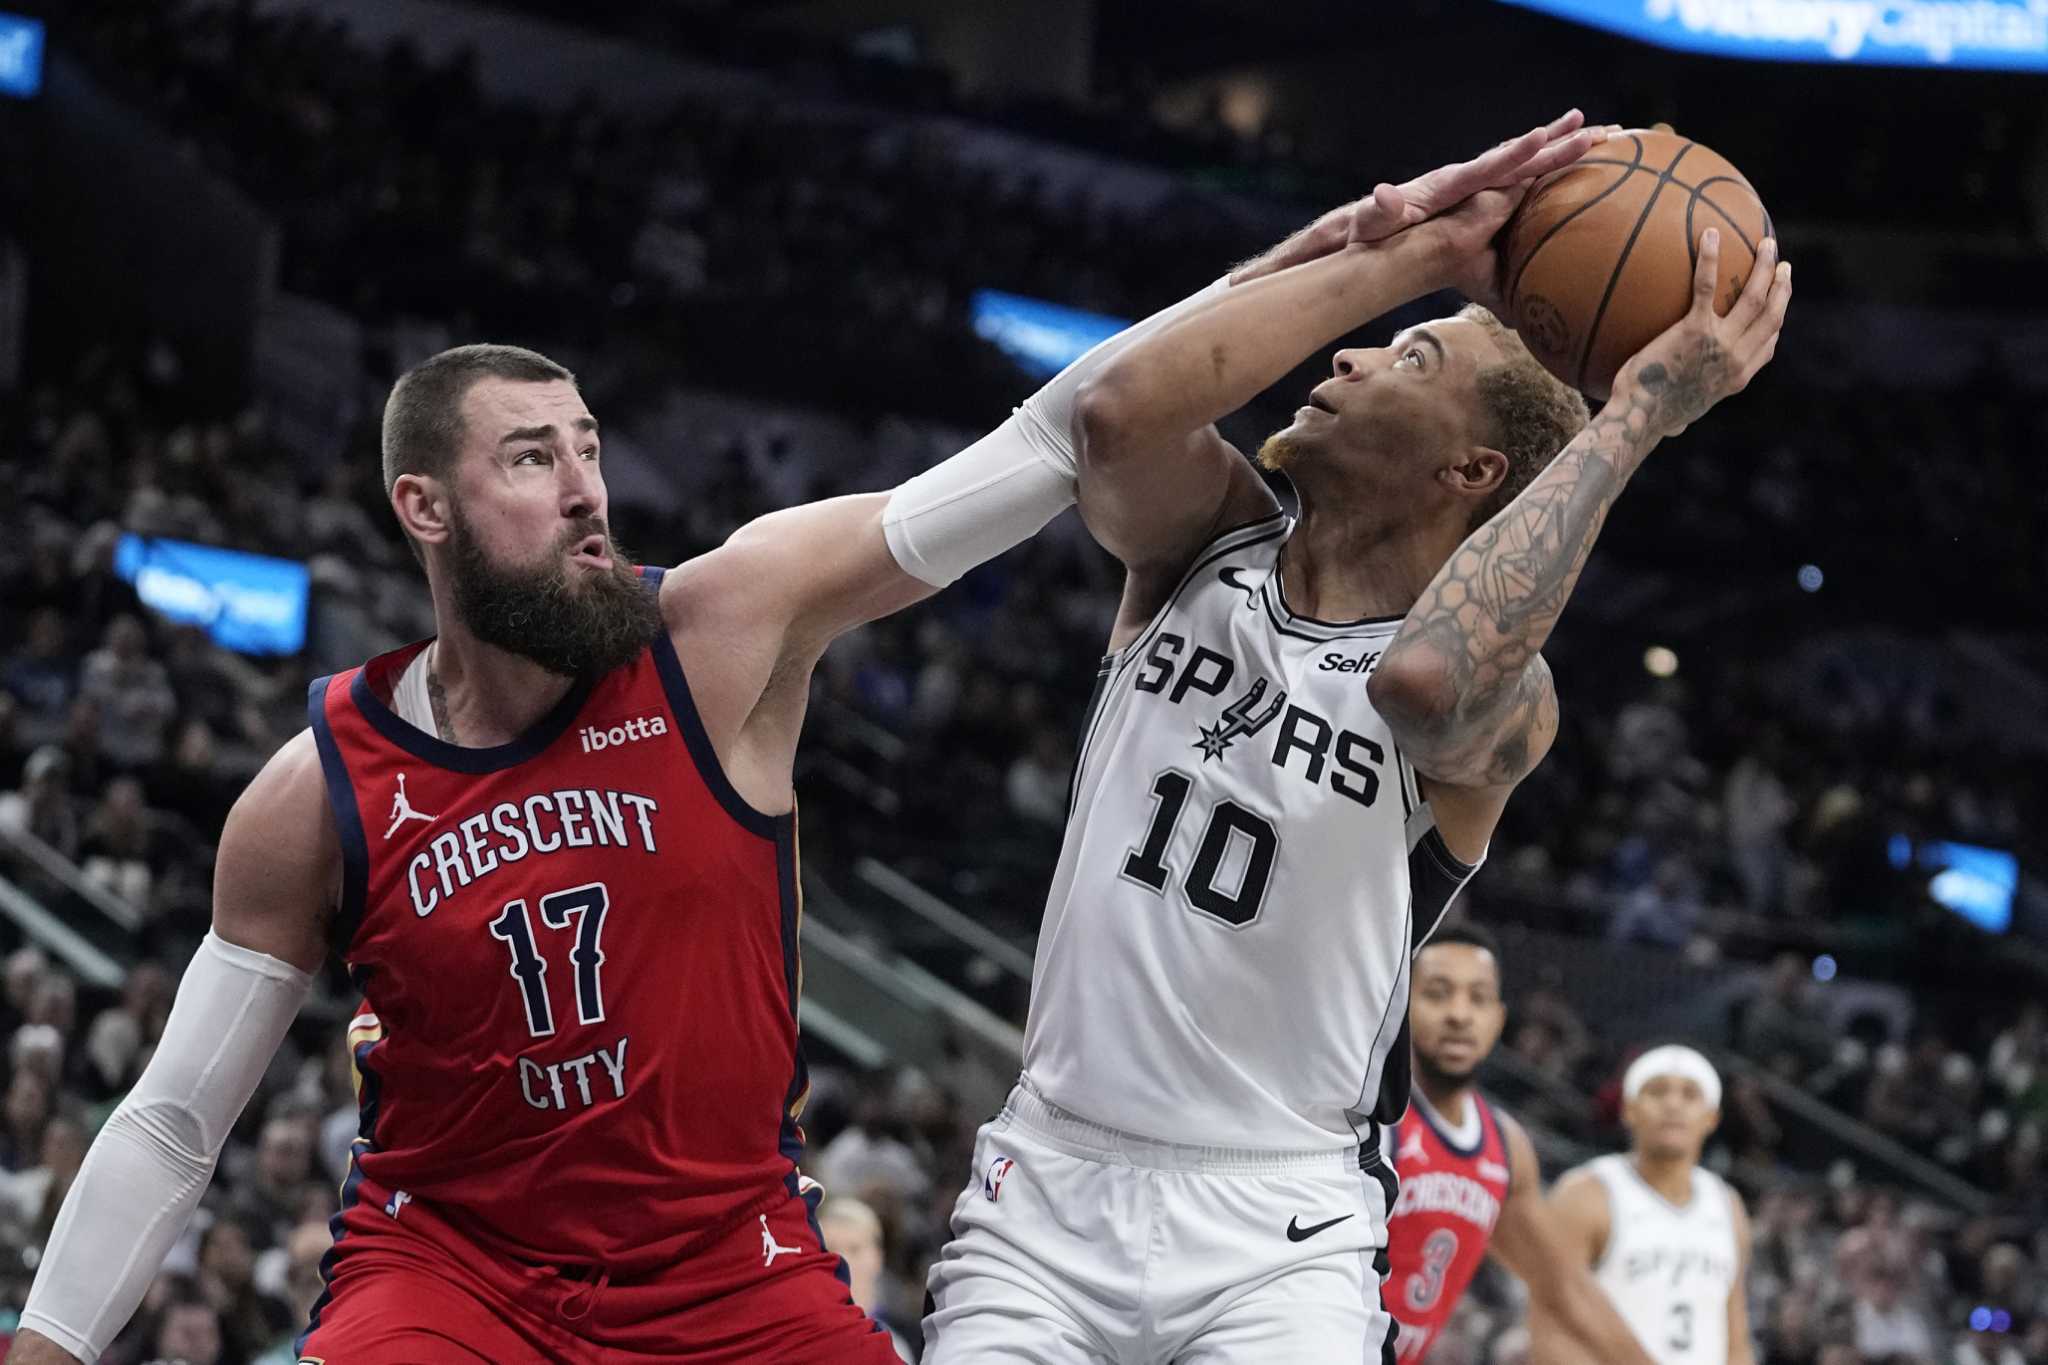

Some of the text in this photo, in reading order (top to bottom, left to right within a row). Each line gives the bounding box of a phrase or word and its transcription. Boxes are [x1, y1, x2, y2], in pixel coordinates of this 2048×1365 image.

[579, 715, 668, 754] ibotta
[1134, 631, 1385, 808] SPURS
[405, 788, 660, 919] CRESCENT
[1117, 767, 1281, 931] 10
[488, 881, 610, 1039] 17
[518, 1037, 629, 1111] CITY
[1393, 1170, 1500, 1234] CRESCEN
[1404, 1227, 1460, 1314] 3
[1667, 1300, 1697, 1355] 3
